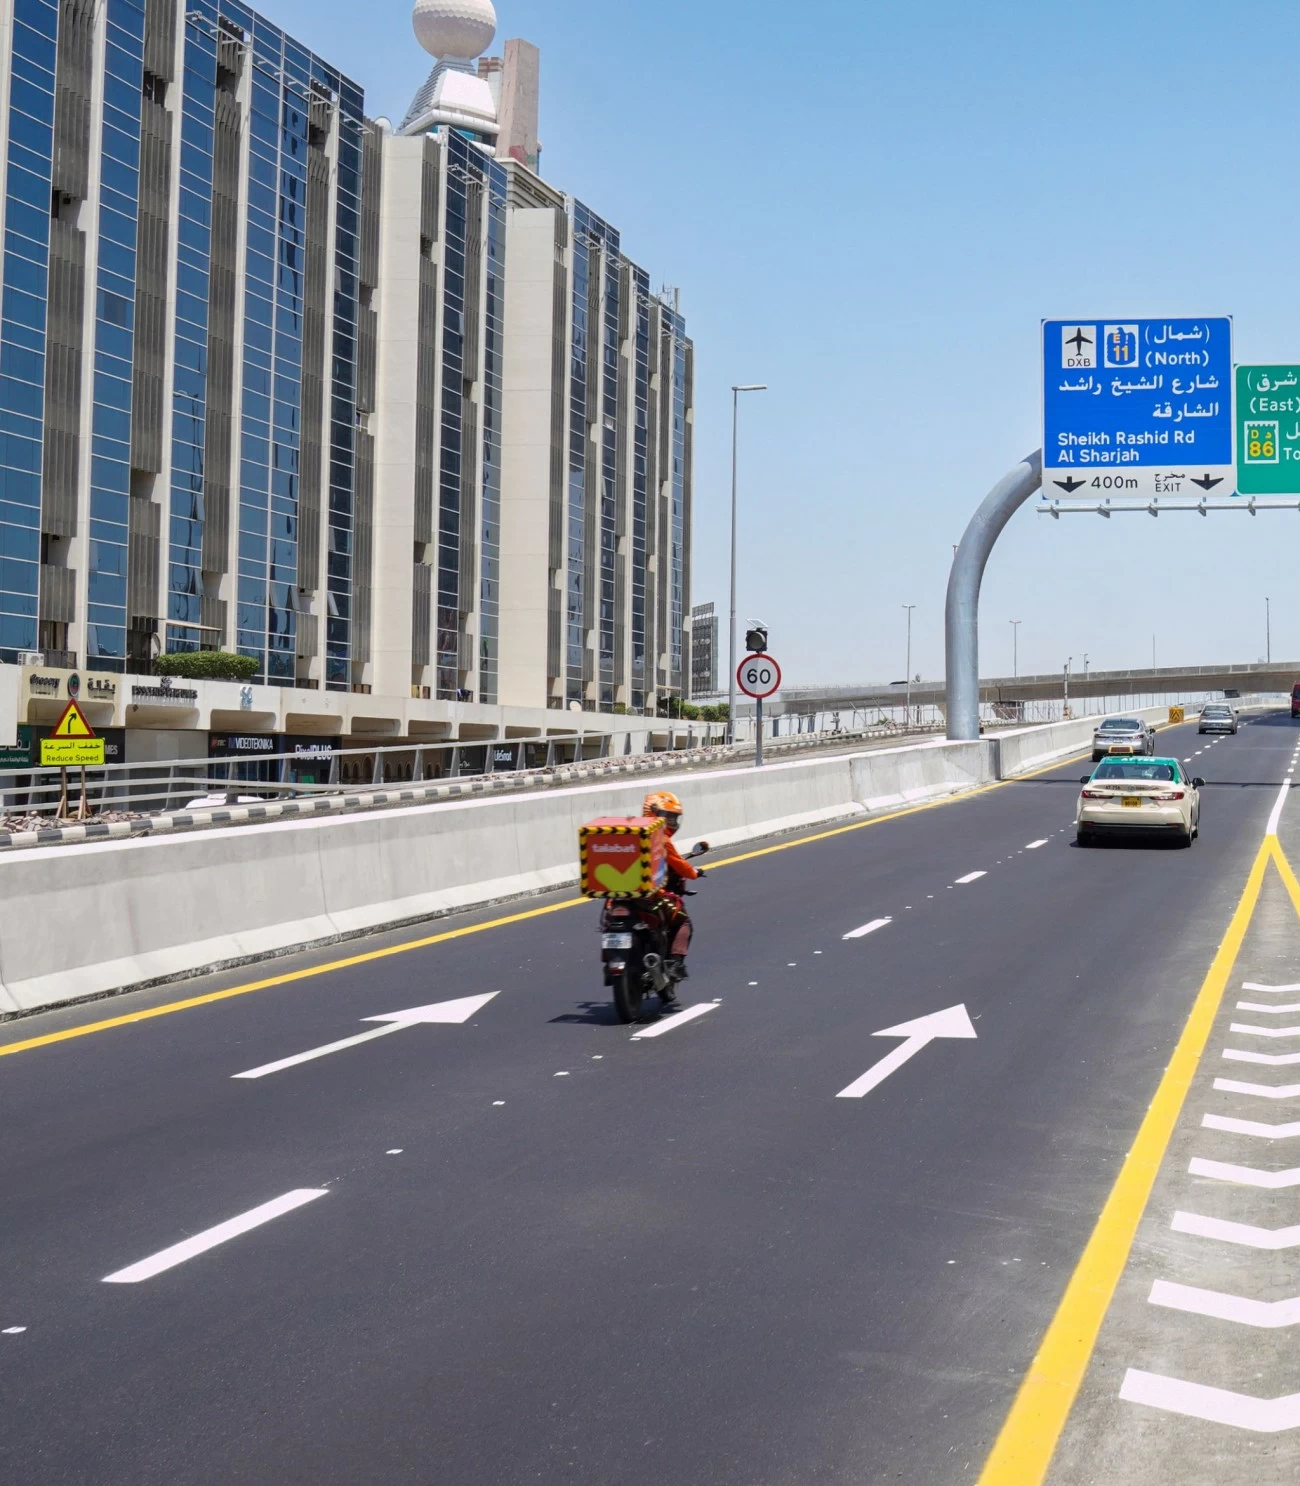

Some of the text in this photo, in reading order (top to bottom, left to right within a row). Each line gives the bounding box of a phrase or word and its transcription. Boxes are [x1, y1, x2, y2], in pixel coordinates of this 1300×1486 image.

[1113, 334, 1120, 343] E
[1114, 345, 1128, 361] 11
[1146, 350, 1209, 367] (North)
[1067, 358, 1091, 367] DXB
[1059, 375, 1219, 396] شارع الشيخ راشد
[1152, 402, 1219, 422] الشارقة
[1058, 430, 1195, 446] Sheikh Rashid Rd
[1251, 430, 1258, 438] D
[1058, 448, 1139, 463] Al Sharjah
[1250, 441, 1274, 456] 86
[1284, 448, 1300, 460] To
[1091, 476, 1138, 489] 400m
[1154, 471, 1185, 482] مخرج
[1155, 482, 1181, 492] EXIT
[747, 668, 770, 684] 60
